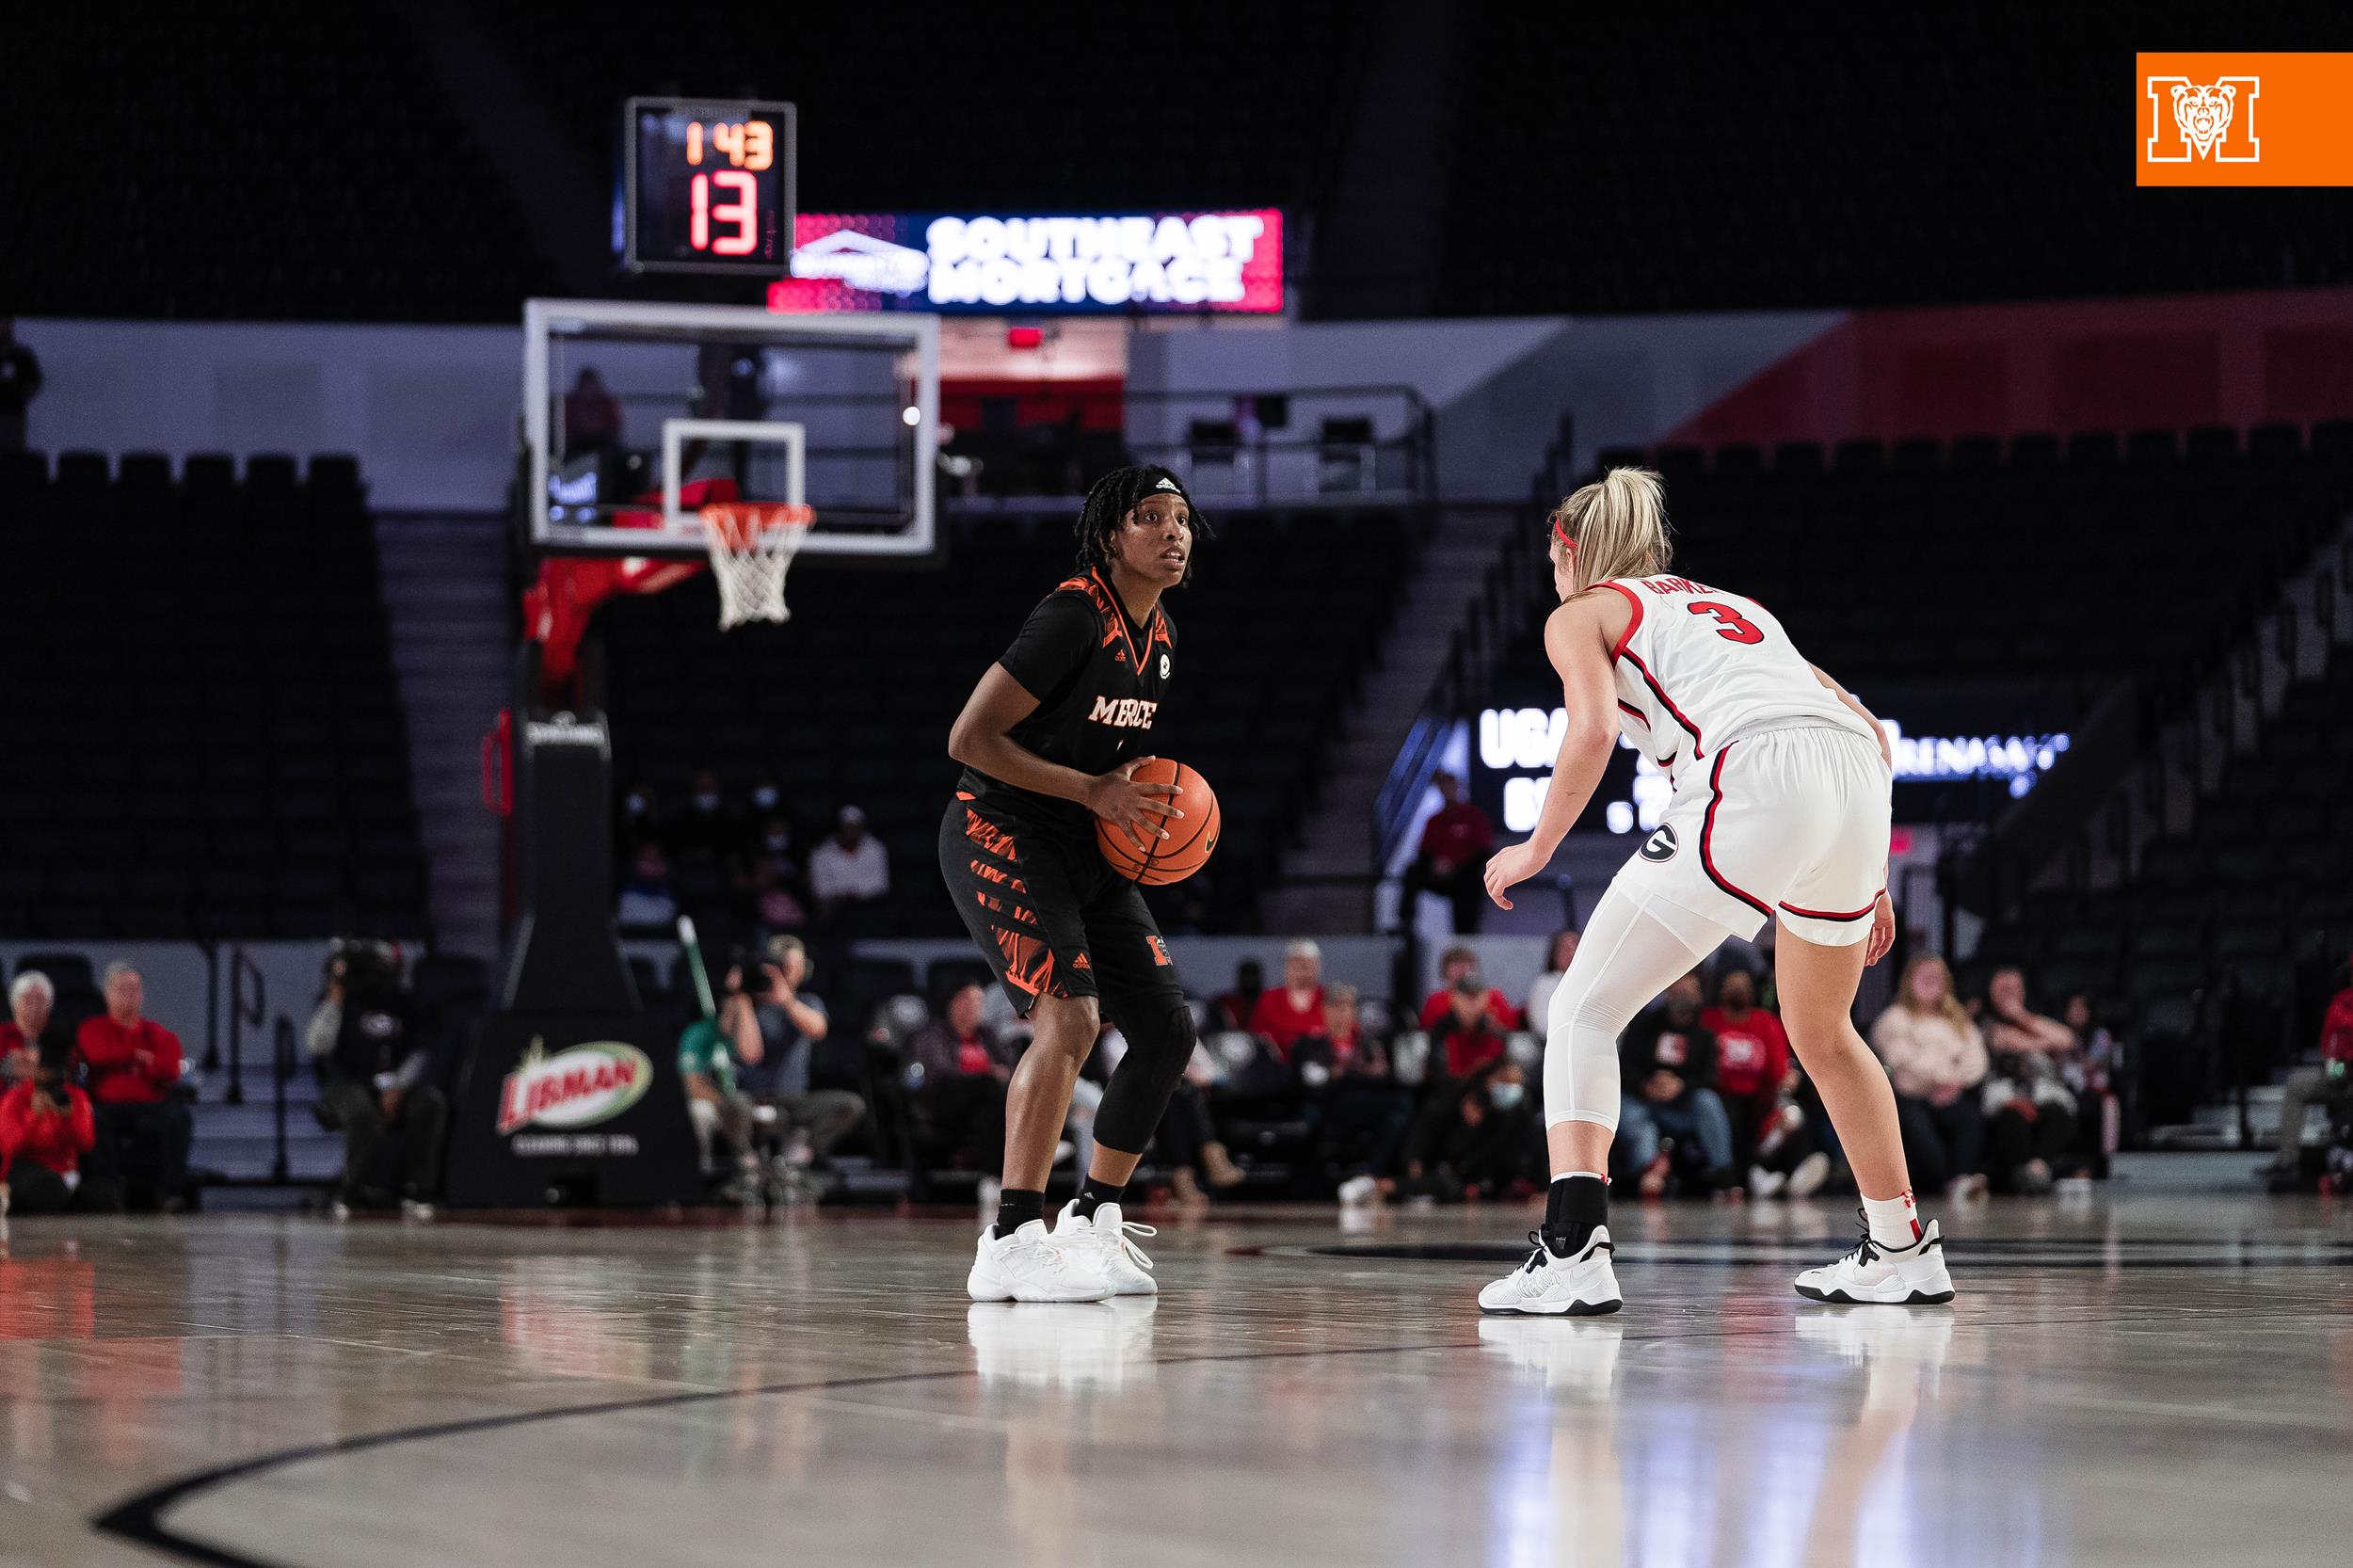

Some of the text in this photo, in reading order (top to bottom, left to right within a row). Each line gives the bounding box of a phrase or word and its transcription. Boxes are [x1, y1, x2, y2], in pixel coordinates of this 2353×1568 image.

[690, 169, 758, 256] 13
[926, 216, 1264, 263] SOUTHEAST
[928, 257, 1245, 305] MORTGAGE
[1687, 600, 1765, 645] 3
